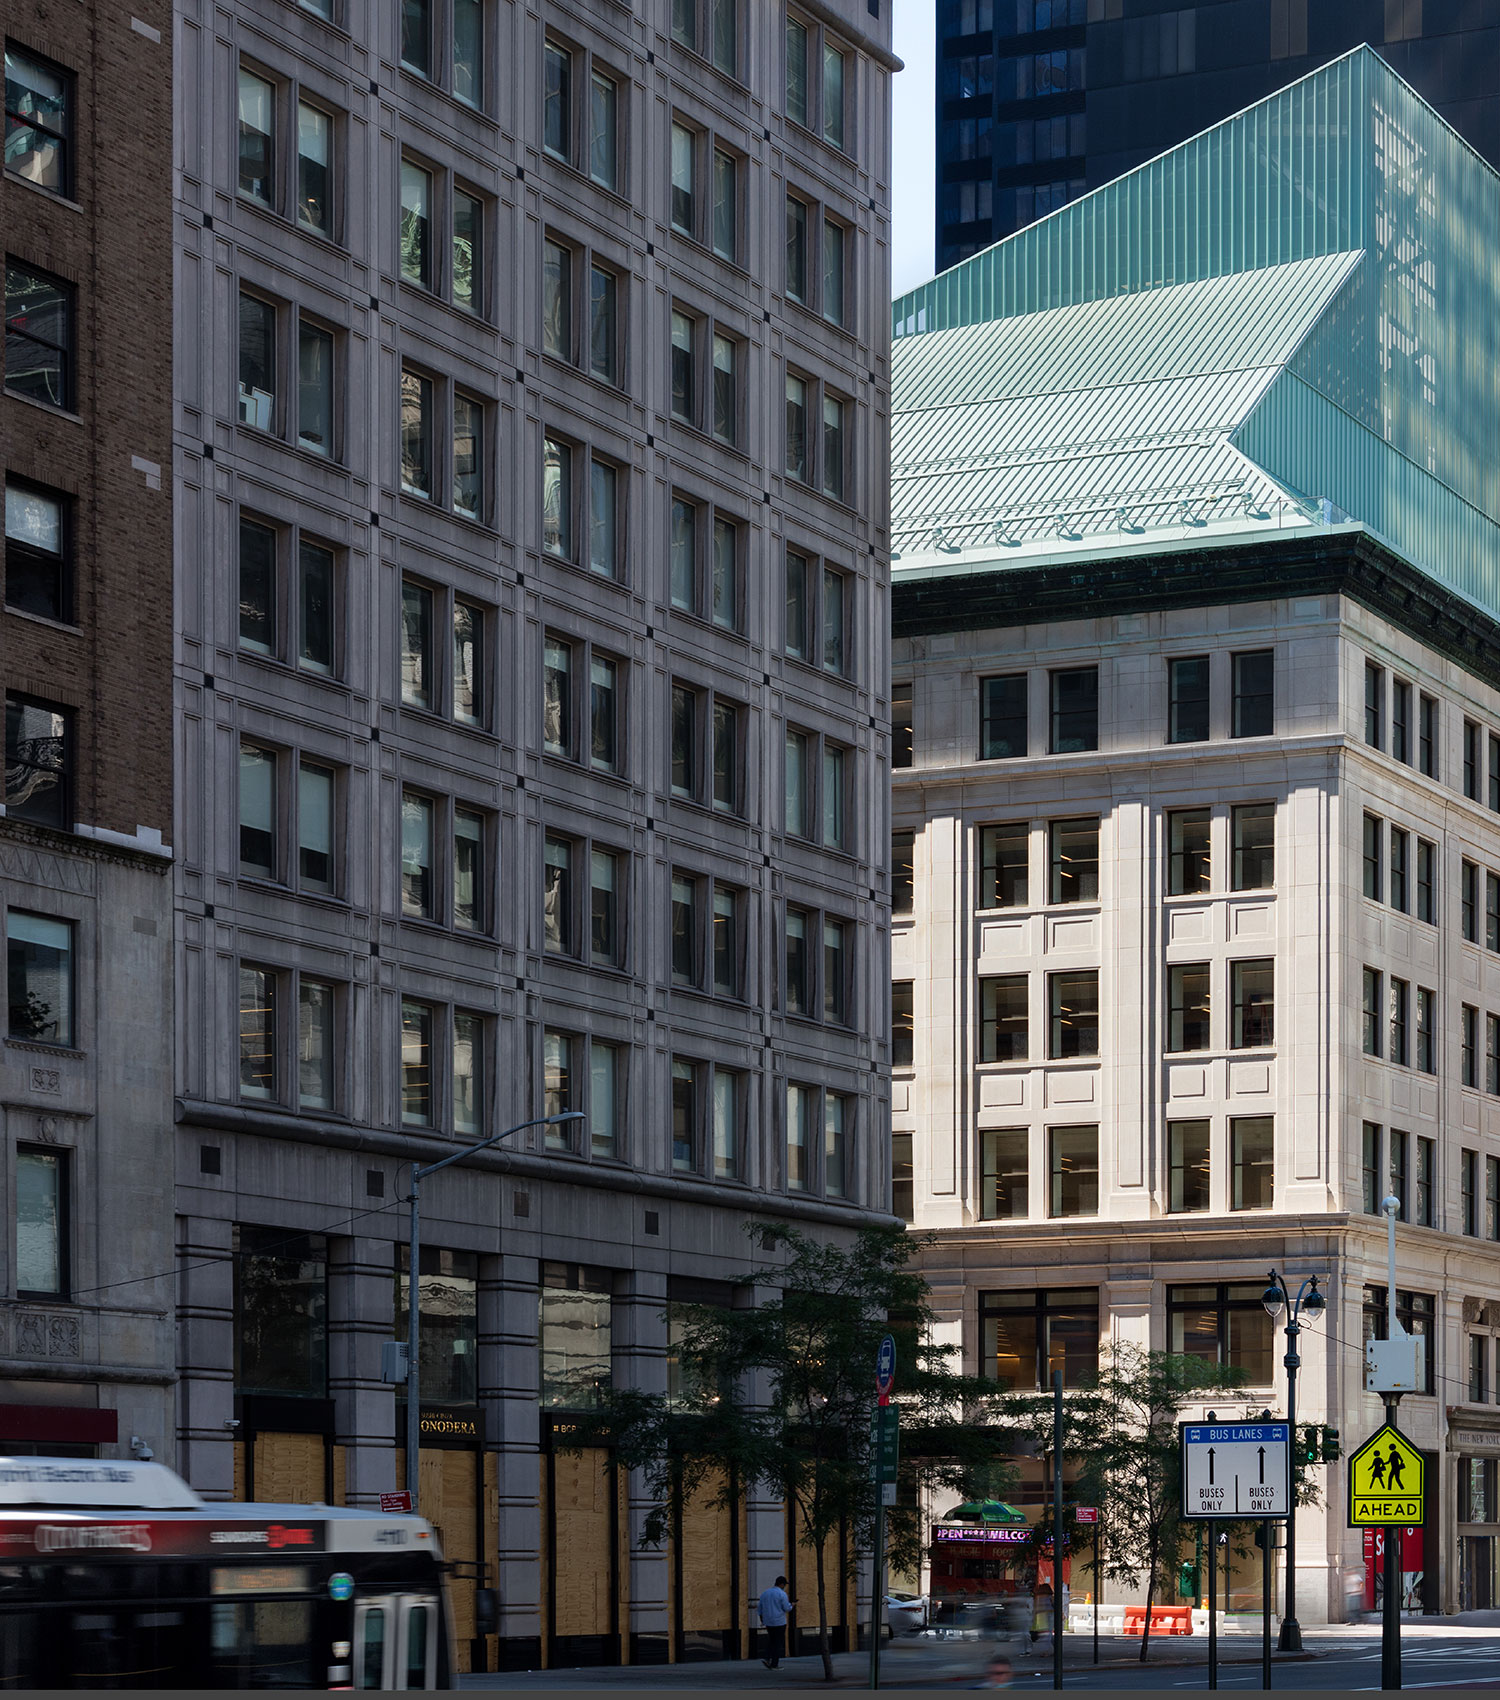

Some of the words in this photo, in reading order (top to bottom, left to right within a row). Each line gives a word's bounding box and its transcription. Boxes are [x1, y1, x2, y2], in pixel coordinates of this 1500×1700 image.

[420, 1419, 476, 1434] ONODERA
[1210, 1429, 1229, 1440] BUS
[1232, 1428, 1263, 1439] LANES
[1459, 1433, 1470, 1443] THE
[1471, 1434, 1483, 1444] NEW
[1486, 1434, 1500, 1445] YORK
[1199, 1488, 1225, 1498] BUSES
[1249, 1487, 1275, 1497] BUSES
[1201, 1501, 1222, 1511] ONLY
[1251, 1500, 1273, 1510] ONLY
[1358, 1503, 1417, 1516] AHEAD
